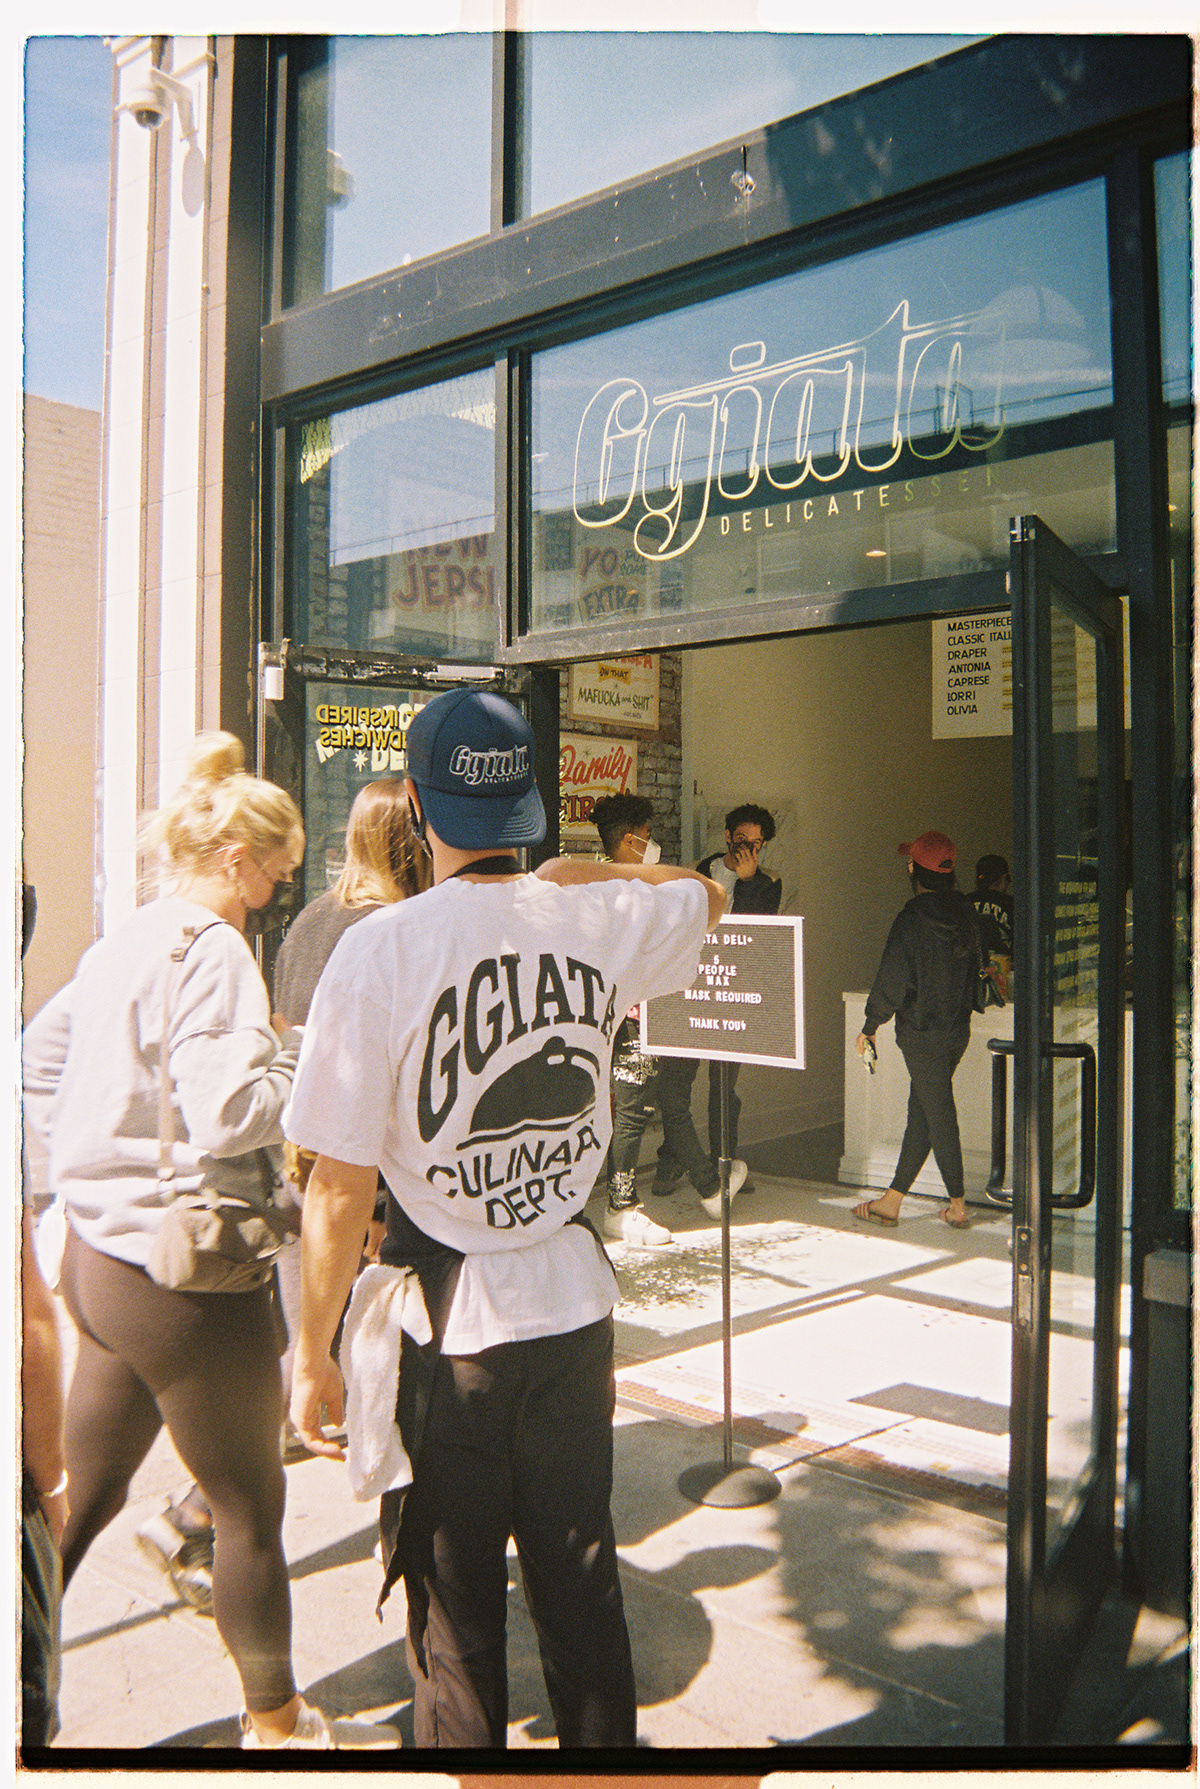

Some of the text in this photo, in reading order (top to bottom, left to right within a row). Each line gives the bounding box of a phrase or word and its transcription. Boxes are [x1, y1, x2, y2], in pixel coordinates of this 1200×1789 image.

[395, 564, 496, 611] JERS
[947, 633, 985, 646] CLASSIC
[947, 647, 987, 660] DRAPER
[948, 661, 991, 674] ANTONIA
[947, 675, 990, 688] CAPRESE
[946, 704, 978, 716] OLIVIA
[698, 964, 737, 977] PEOPLE
[706, 975, 730, 987] MAX
[684, 989, 762, 1004] MASK REQUIRED
[689, 1017, 720, 1030] THANK
[426, 1119, 601, 1199] CULINAR
[485, 1169, 576, 1229] DEPT.
